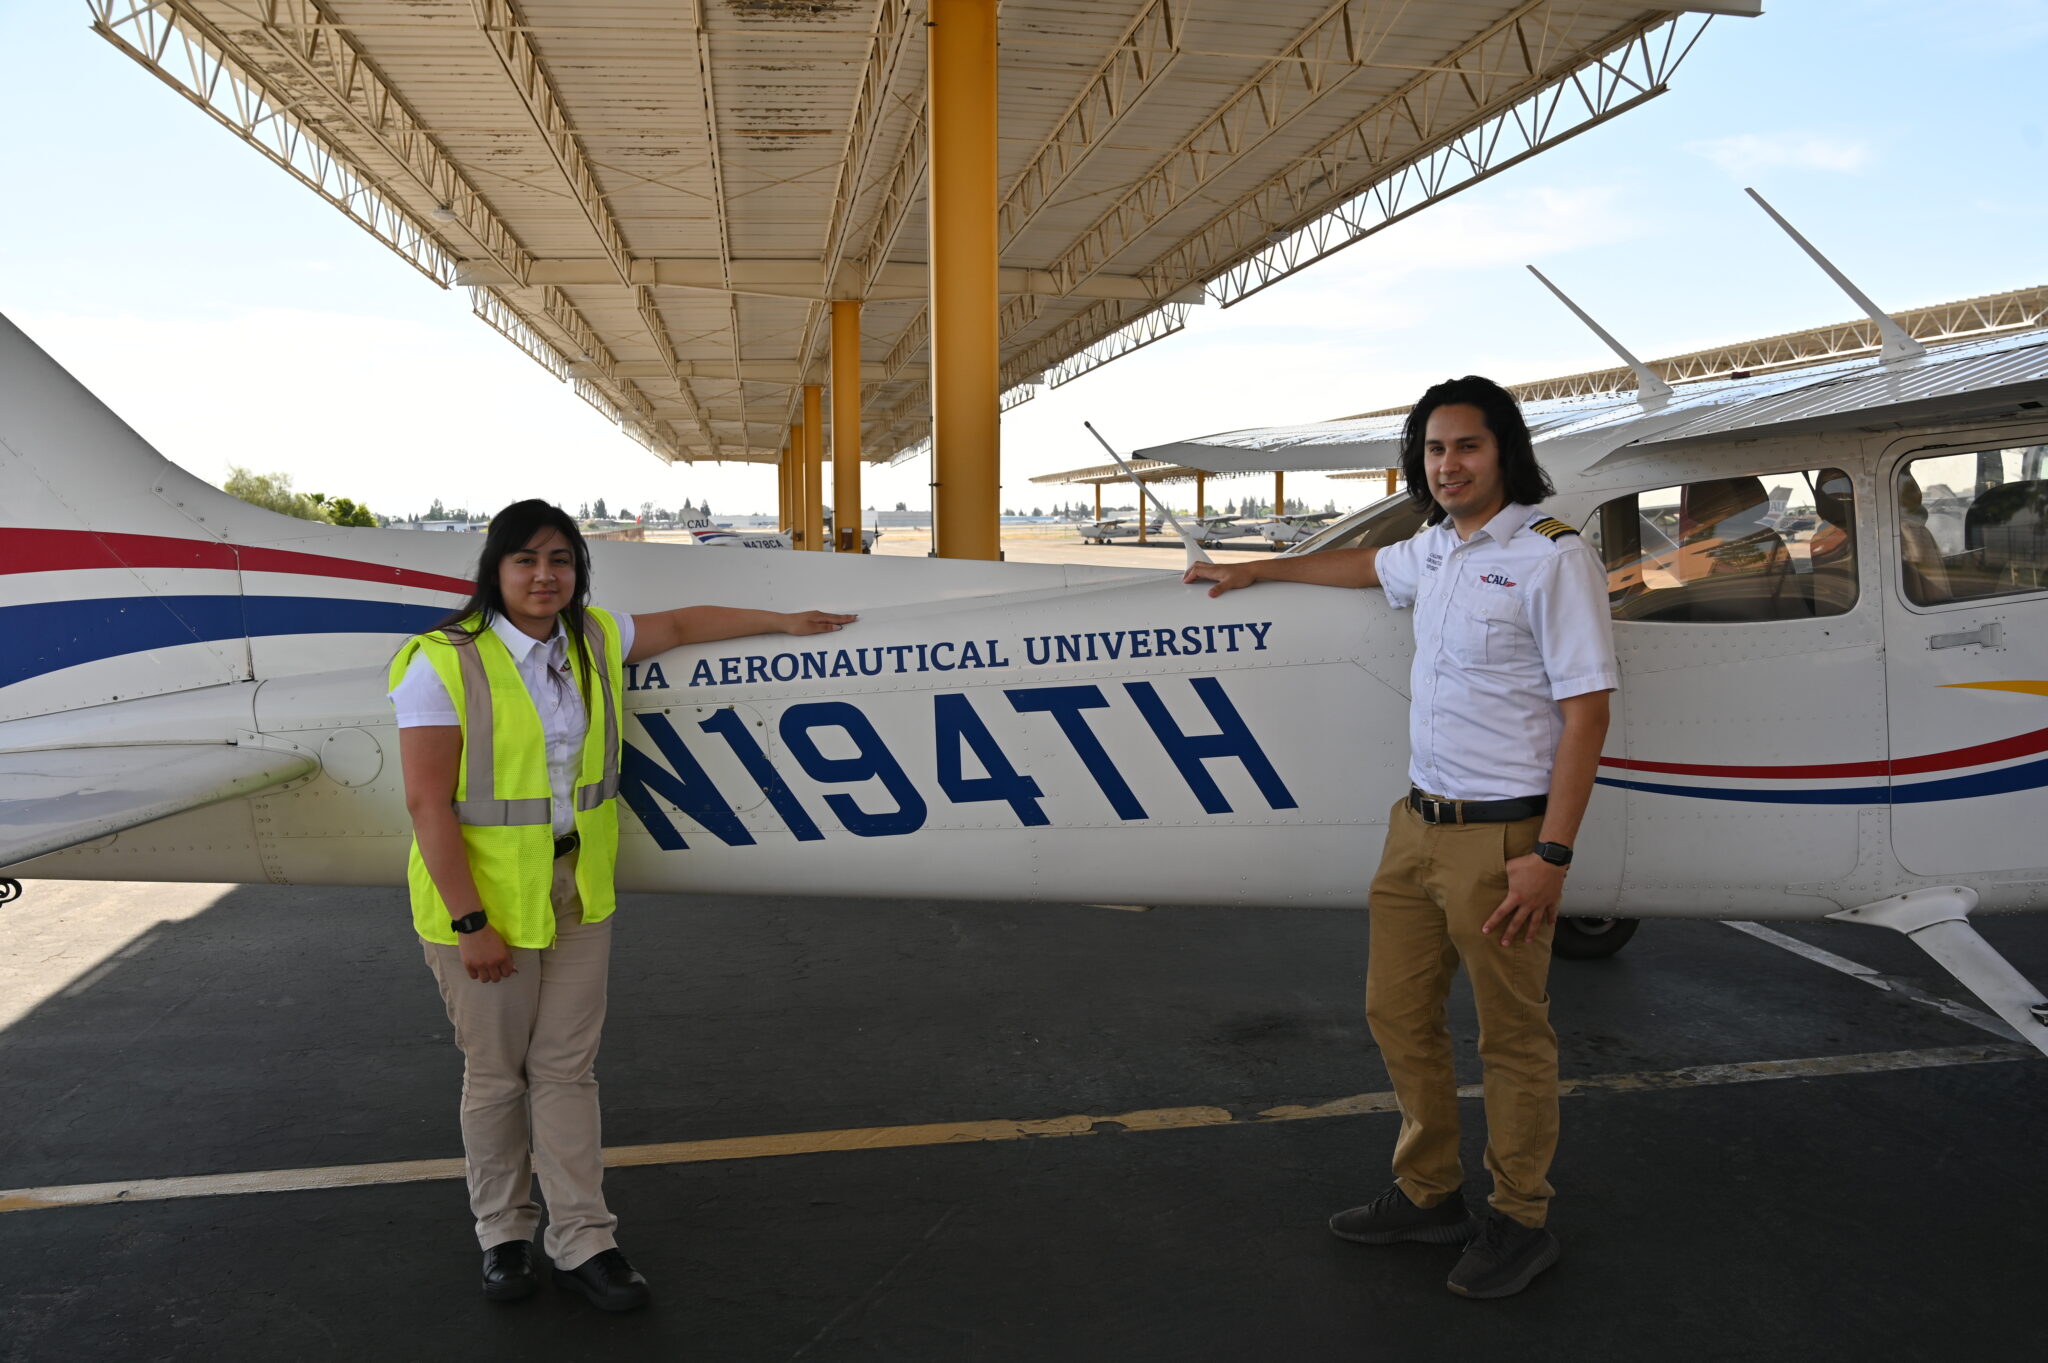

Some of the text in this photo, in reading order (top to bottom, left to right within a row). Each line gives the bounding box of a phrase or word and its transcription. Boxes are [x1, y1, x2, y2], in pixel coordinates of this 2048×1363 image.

[687, 519, 709, 529] CAU
[1487, 573, 1509, 586] CAU
[688, 639, 1009, 688] AERONAUTICAL
[1023, 621, 1273, 666] UNIVERSITY
[621, 676, 1299, 851] N194TH
